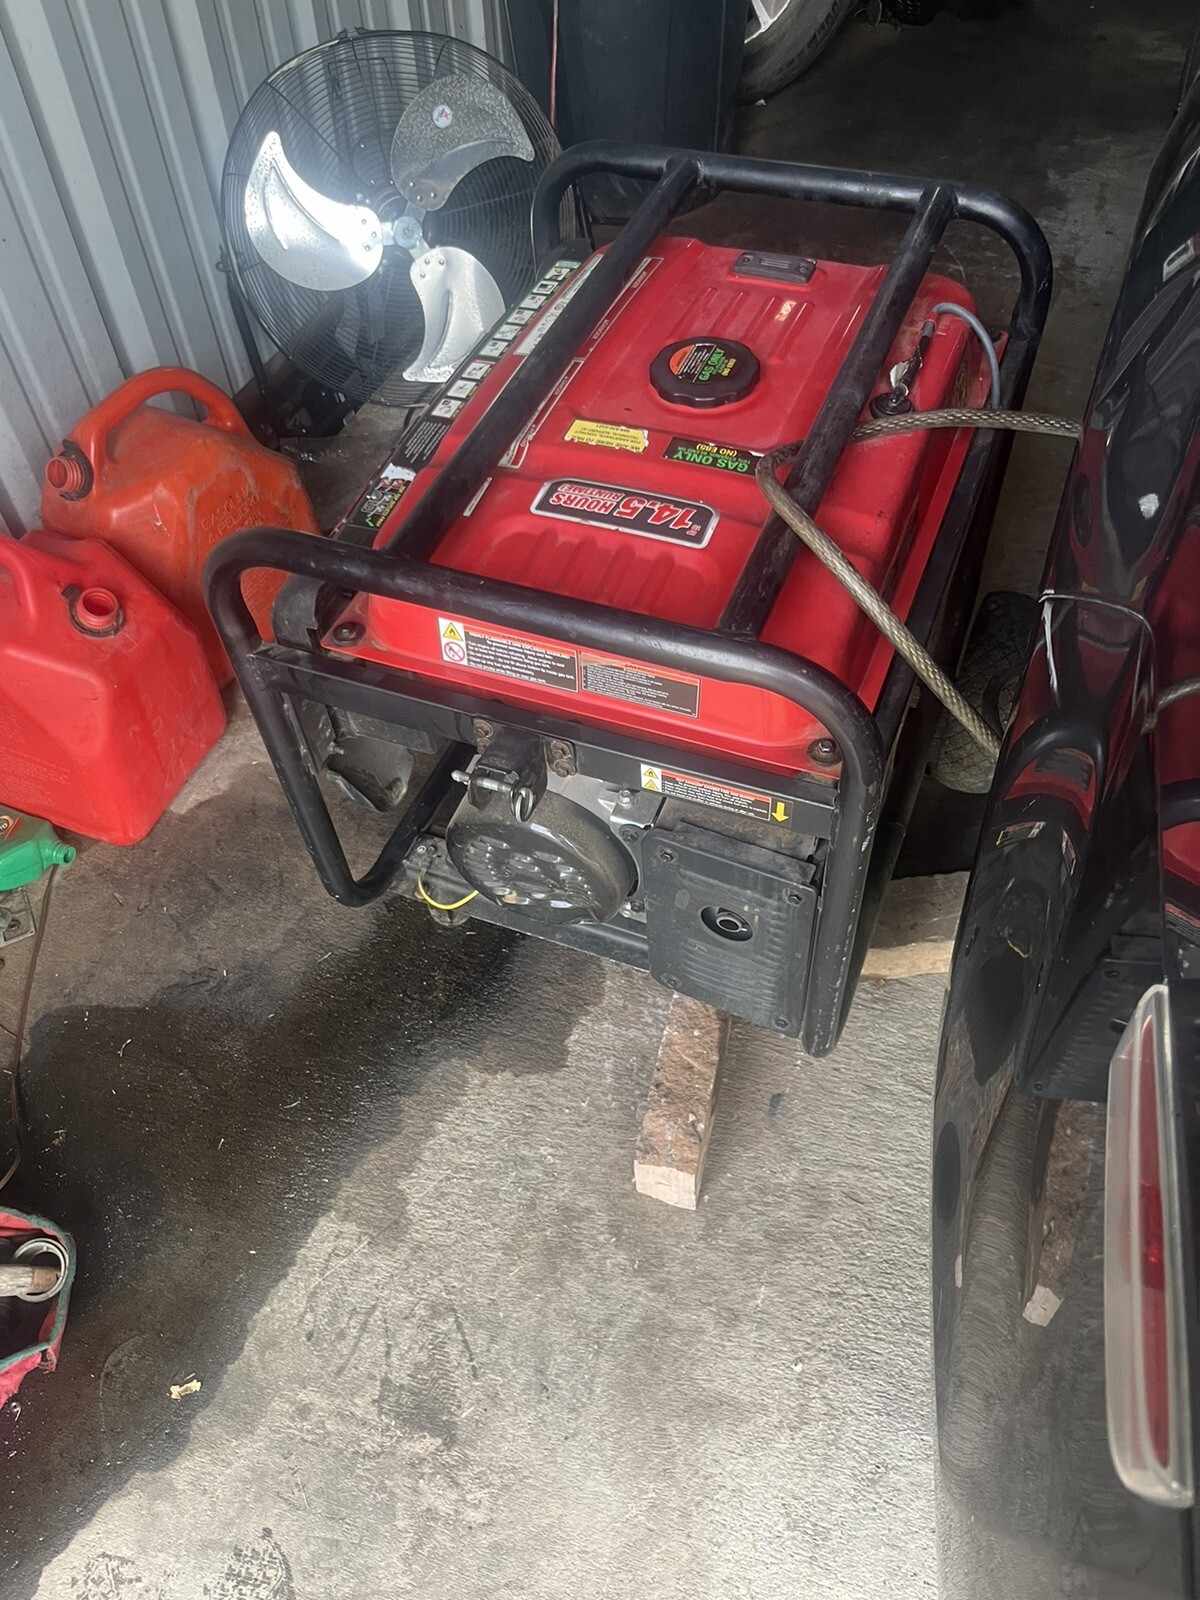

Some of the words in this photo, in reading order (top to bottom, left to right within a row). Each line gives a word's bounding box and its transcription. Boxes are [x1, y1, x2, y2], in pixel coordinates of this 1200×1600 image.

[695, 443, 717, 453] E85)
[718, 447, 737, 457] (NO
[673, 450, 713, 466] ONLY
[716, 457, 748, 472] GAS
[558, 484, 623, 501] RUNTIME!
[550, 492, 615, 514] HOURS
[614, 496, 696, 530] 14.5
